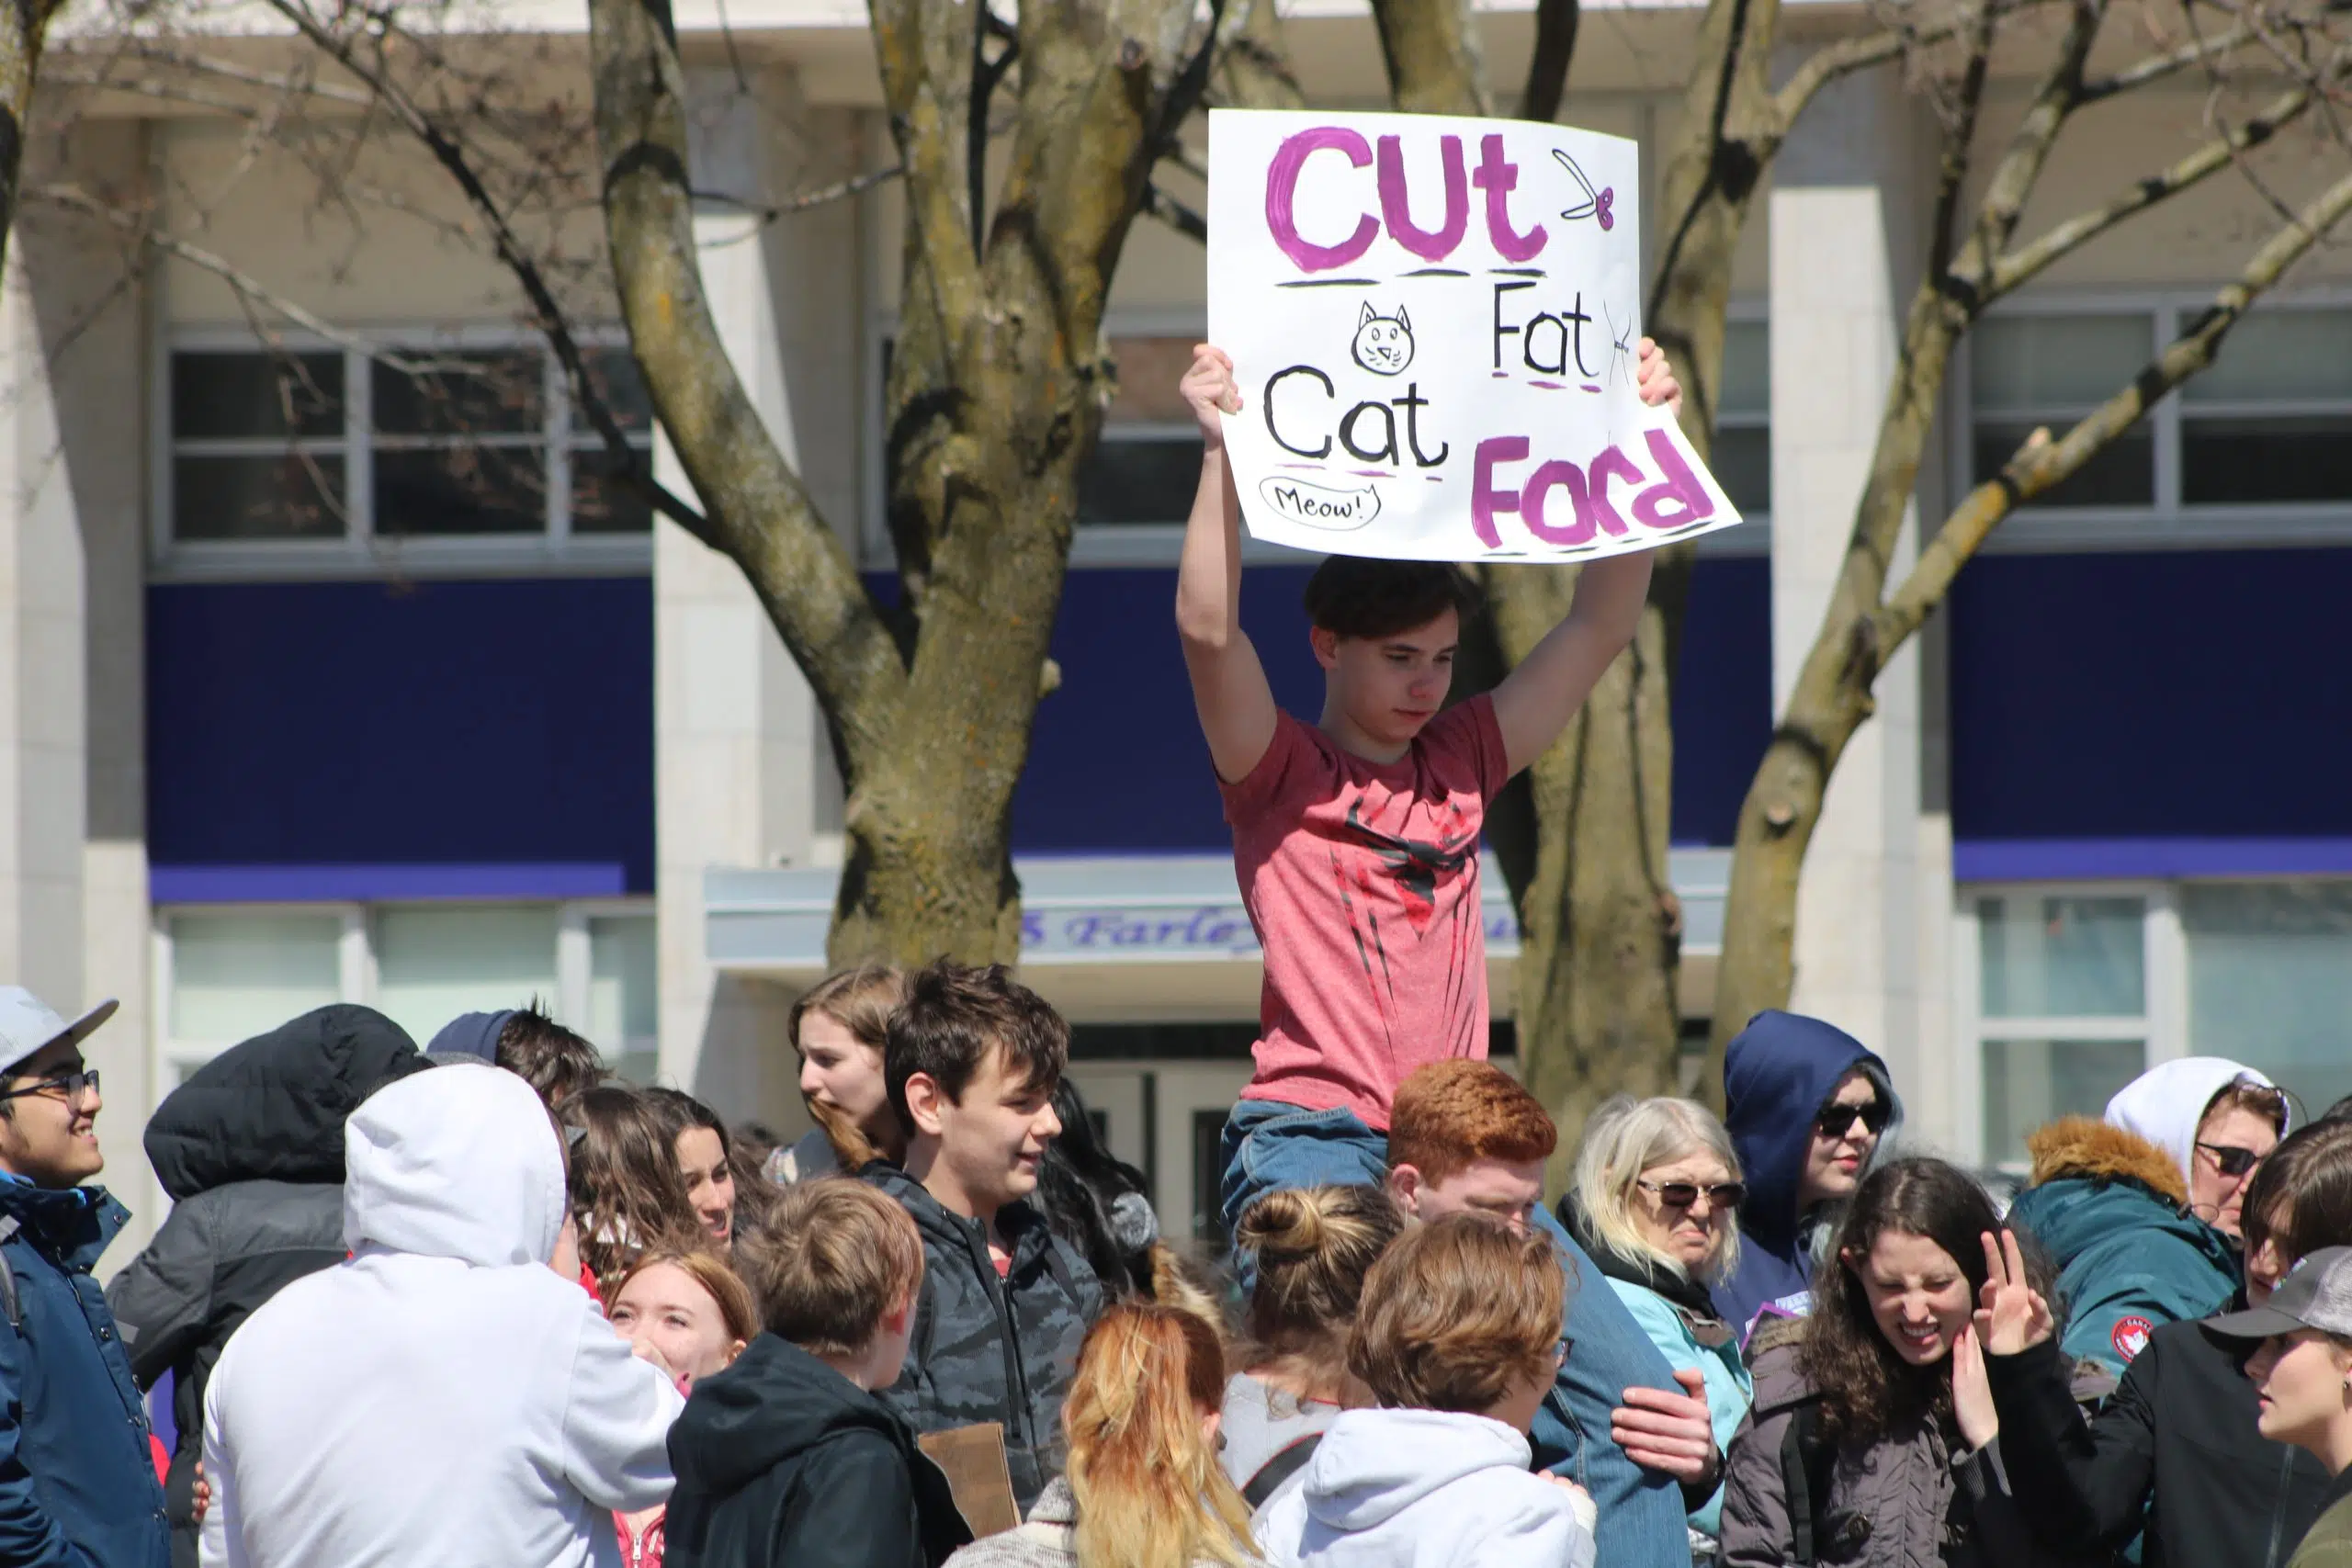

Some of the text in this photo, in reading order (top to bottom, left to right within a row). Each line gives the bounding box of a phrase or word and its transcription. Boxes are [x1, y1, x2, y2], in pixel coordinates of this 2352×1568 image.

[1493, 280, 1600, 378] Fat
[1262, 364, 1449, 468] Cat
[1273, 486, 1363, 520] Meow!
[1471, 429, 1714, 549] Ford
